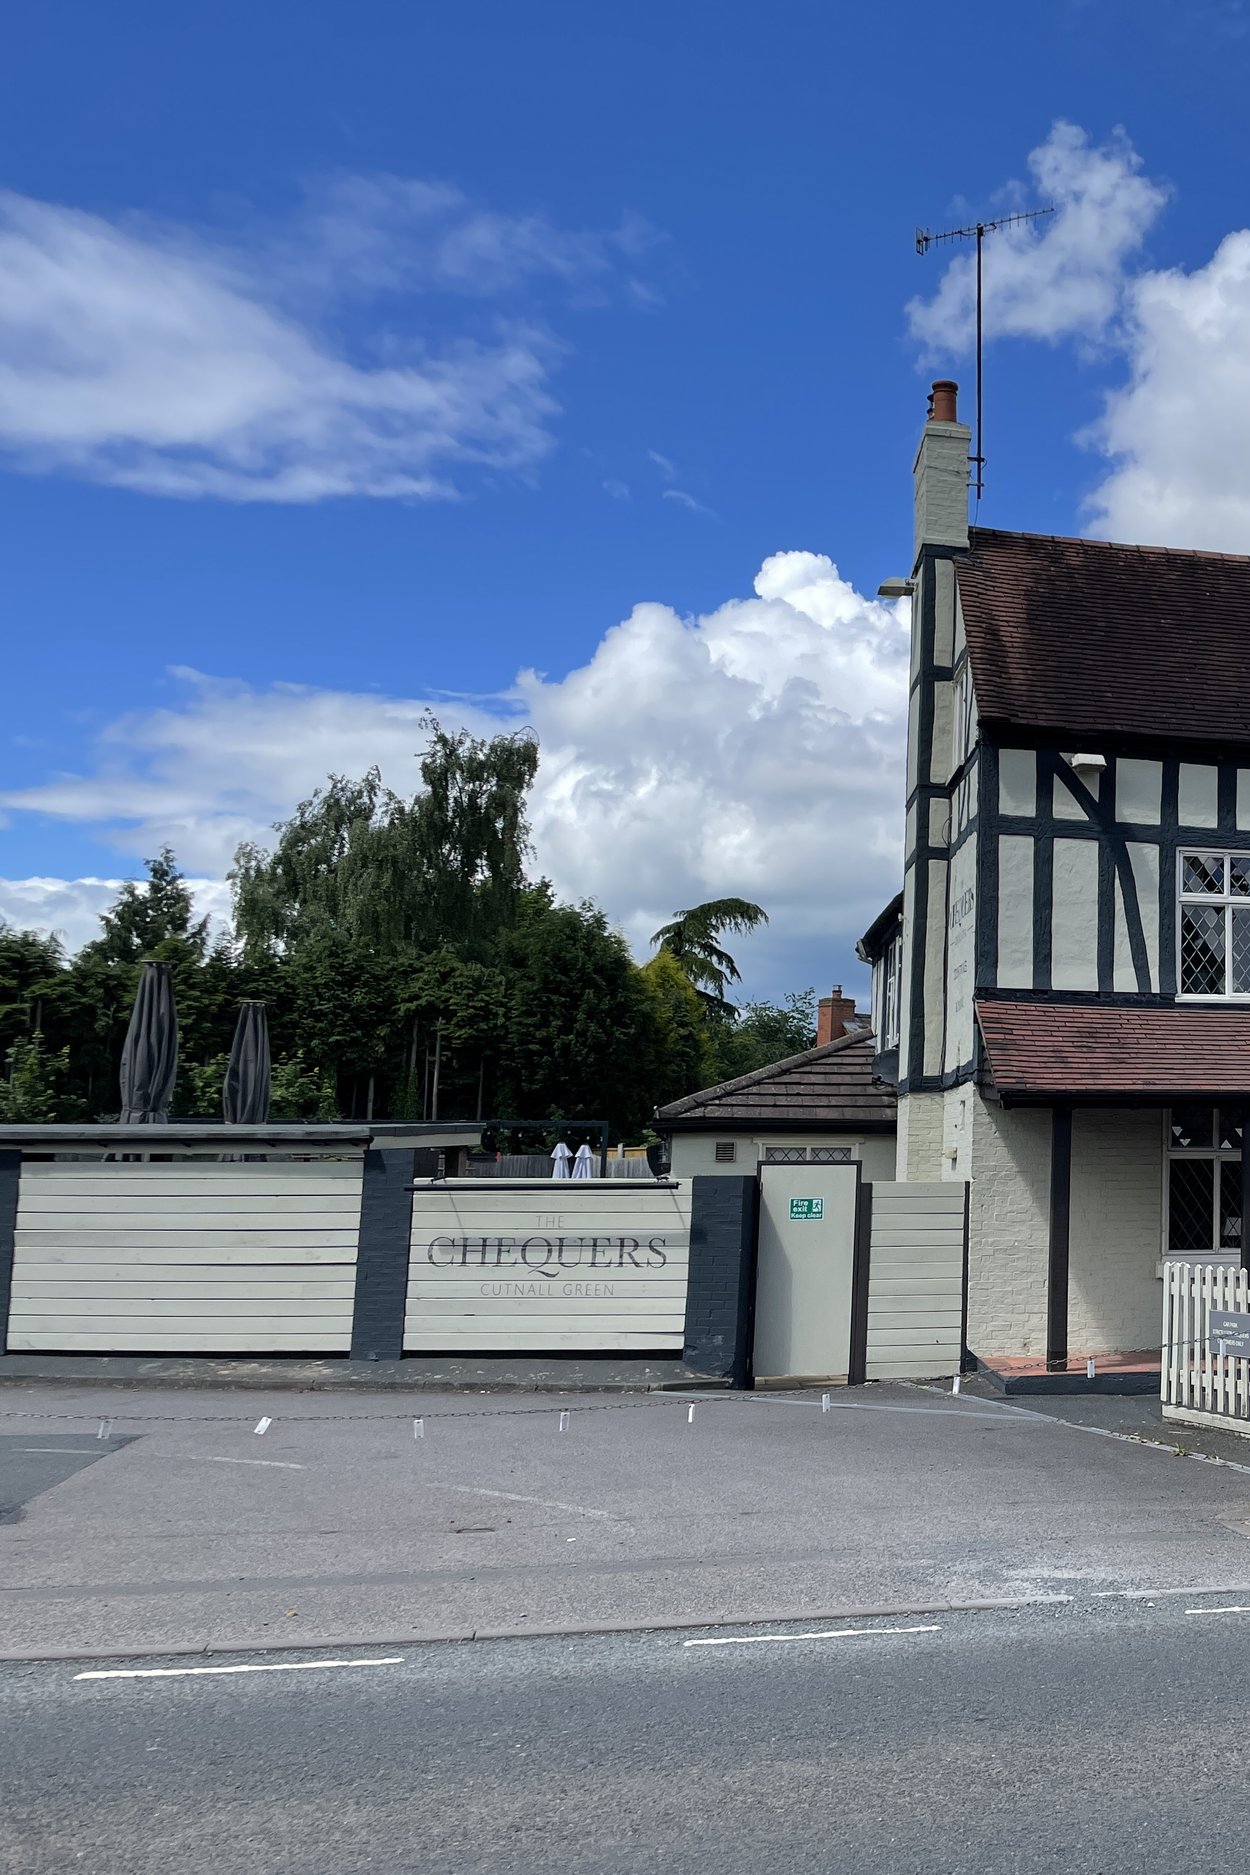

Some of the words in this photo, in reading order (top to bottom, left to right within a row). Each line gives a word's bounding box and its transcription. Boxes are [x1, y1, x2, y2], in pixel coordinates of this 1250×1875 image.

[536, 1215, 565, 1228] THE
[427, 1236, 668, 1278] CHEQUERS
[480, 1283, 552, 1296] CUTNALL
[562, 1283, 614, 1296] GREEN
